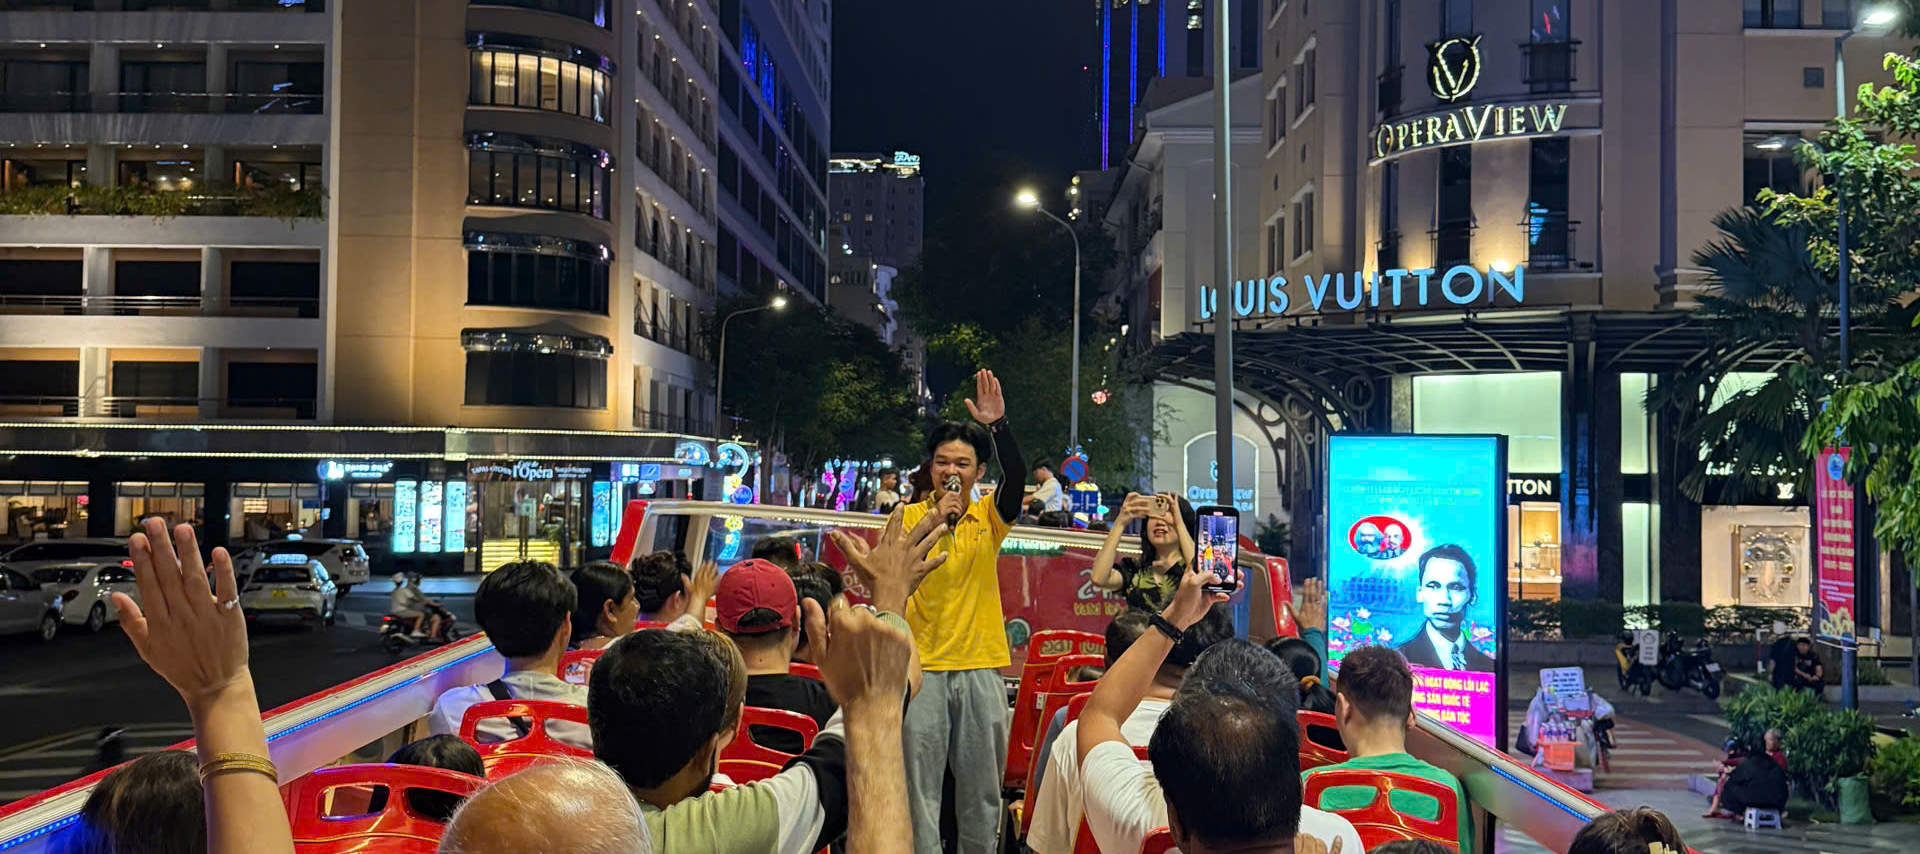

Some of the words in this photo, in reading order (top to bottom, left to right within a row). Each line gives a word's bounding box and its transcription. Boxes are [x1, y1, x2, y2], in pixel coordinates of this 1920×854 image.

[1376, 103, 1568, 158] OPERAVIEW
[1200, 276, 1290, 319] LUIS
[1303, 264, 1525, 312] VUITTON
